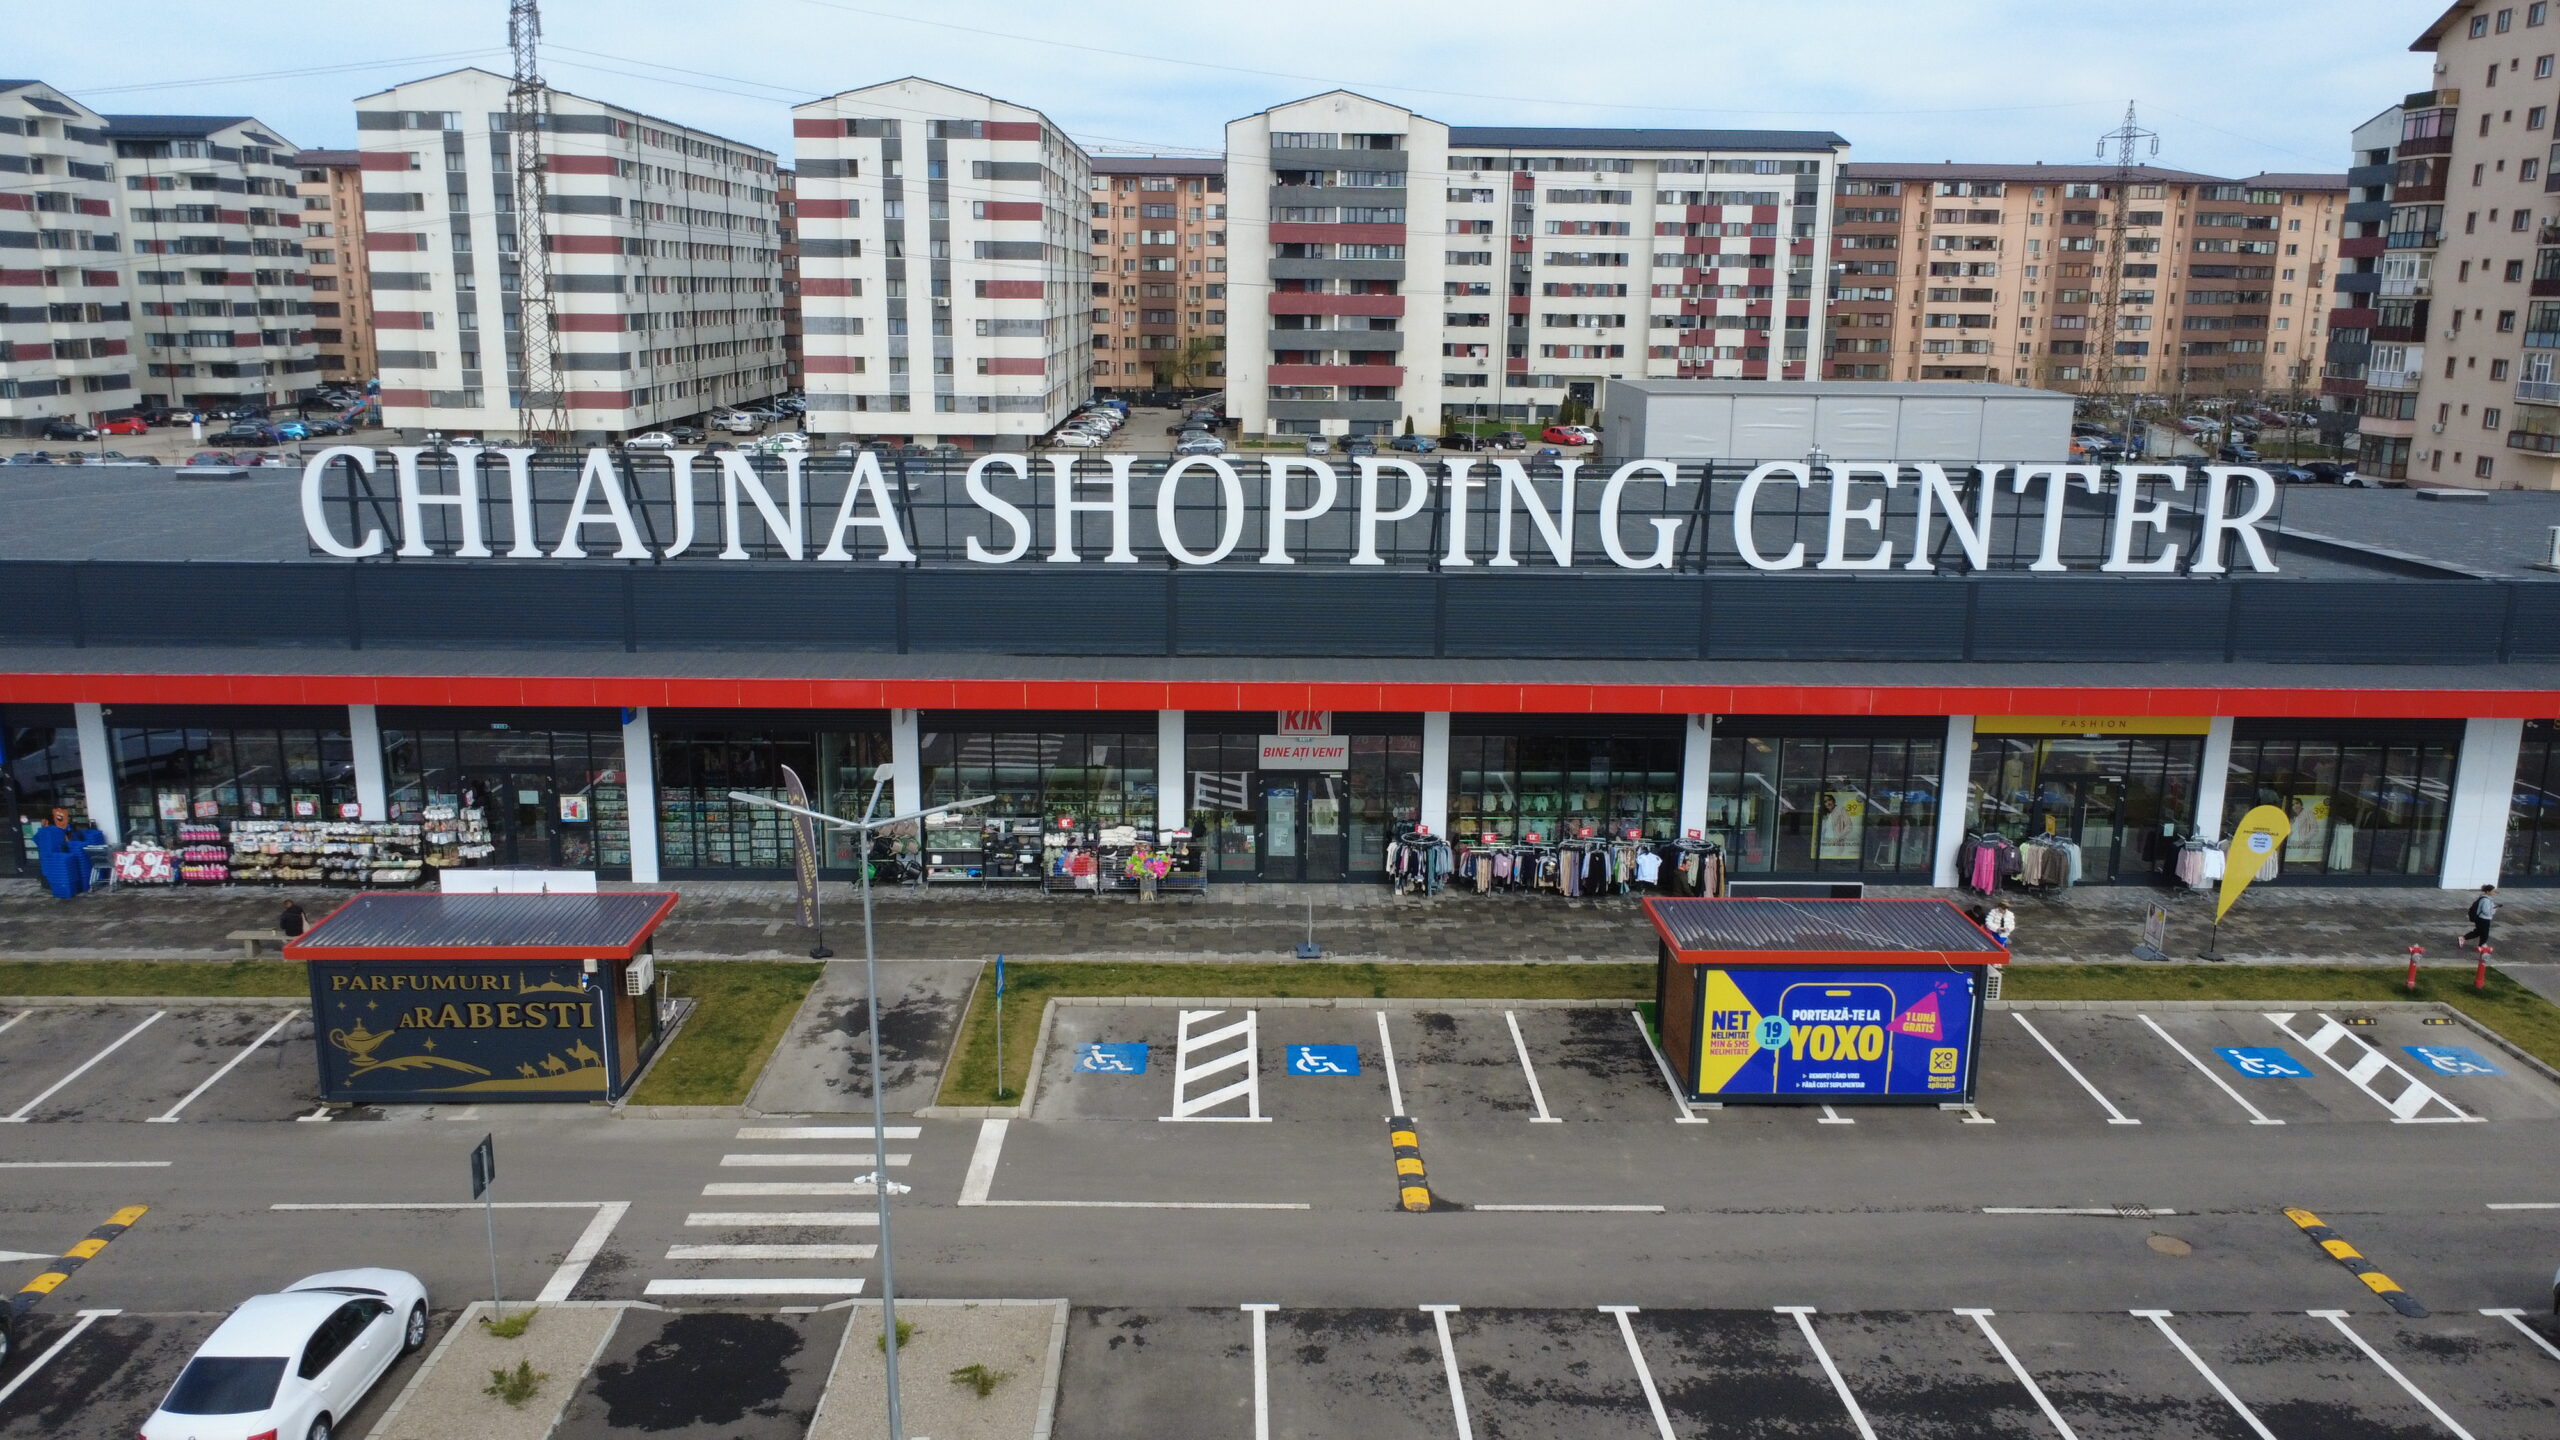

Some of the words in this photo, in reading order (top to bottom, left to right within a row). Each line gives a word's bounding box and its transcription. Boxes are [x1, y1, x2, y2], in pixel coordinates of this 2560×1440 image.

[301, 445, 917, 562] CHIAJNA
[965, 453, 1685, 570] SHOPPING
[1733, 460, 2280, 574] CENTER
[2060, 719, 2127, 728] FASHION
[1263, 747, 1290, 758] BINE
[1312, 747, 1344, 758] VENIT
[331, 975, 512, 991] PARFUMURI
[400, 1002, 595, 1029] ARABESTI
[1711, 1010, 1751, 1030] NET
[1792, 1007, 1865, 1021] PORTEAZĂ-TE
[1866, 1009, 1880, 1021] LA
[1911, 1012, 1936, 1023] LUNĂ
[1764, 1021, 1782, 1038] 19
[1902, 1022, 1935, 1033] GRATIS
[1710, 1031, 1750, 1039] NELIMITAT
[1710, 1040, 1725, 1048] MIN
[1734, 1040, 1750, 1048] SMS
[1789, 1025, 1884, 1061] YOXO
[1710, 1048, 1749, 1056] NELIMITATE
